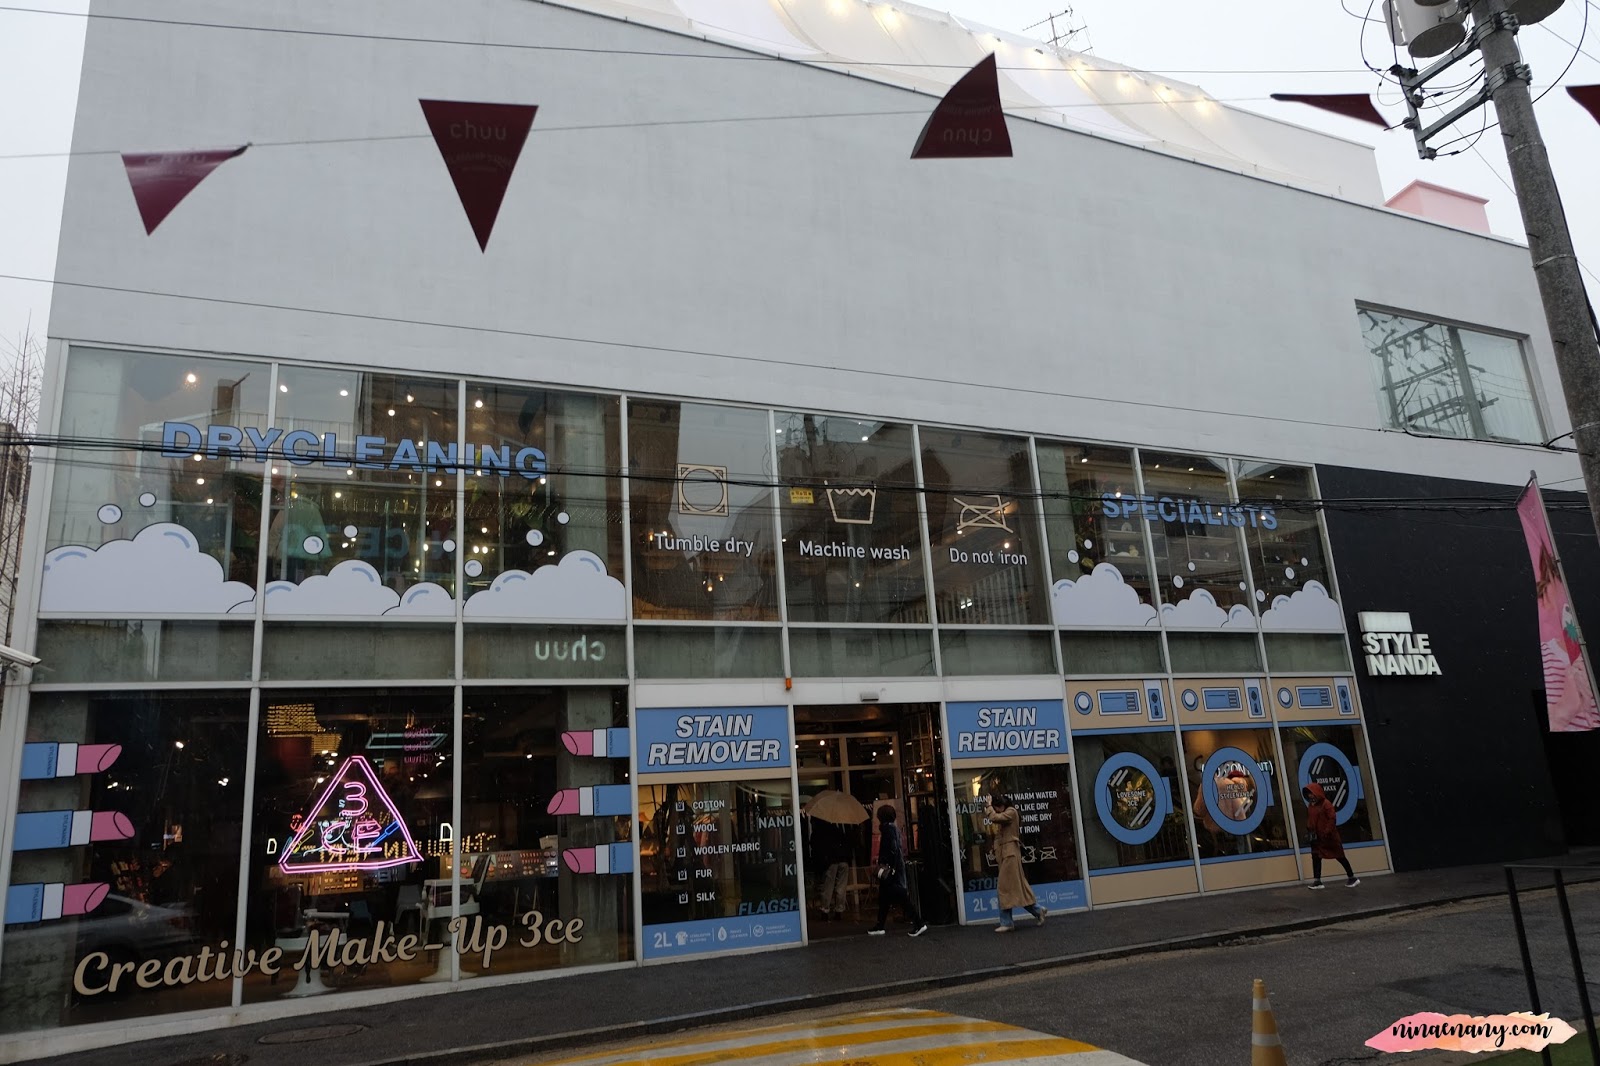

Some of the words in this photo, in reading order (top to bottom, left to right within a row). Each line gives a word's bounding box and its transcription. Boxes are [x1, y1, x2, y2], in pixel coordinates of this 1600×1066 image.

[448, 119, 508, 142] chuu
[161, 421, 547, 479] DRYCLEANING
[1102, 492, 1278, 531] SPECIALISTS
[654, 533, 720, 553] Tumble
[725, 535, 754, 557] dry
[799, 540, 866, 558] Machine
[870, 544, 911, 560] wash
[949, 548, 969, 563] Do
[972, 549, 995, 565] not
[1000, 550, 1028, 566] iron
[1362, 632, 1432, 655] STYLE
[1364, 653, 1442, 676] NANDA
[675, 714, 754, 739] STAIN
[977, 707, 1037, 728] STAIN
[958, 729, 1060, 752] REMOVER
[647, 738, 781, 767] REMOVER
[343, 781, 369, 816] 3
[692, 799, 725, 810] COTTON
[1013, 792, 1035, 801] WARM
[1035, 790, 1057, 799] WATER
[1020, 803, 1035, 811] LIKE
[1036, 802, 1049, 810] DRY
[1039, 813, 1052, 821] DRY
[693, 823, 718, 833] WOOL
[1024, 825, 1040, 834] IRON
[694, 844, 730, 855] WOOLEN
[731, 842, 760, 853] FABRIC
[695, 868, 713, 879] FUR
[695, 891, 715, 902] SILK
[972, 897, 988, 912] 2L
[653, 931, 672, 949] 2L
[72, 940, 283, 997] Creative
[520, 910, 585, 948] 3ce
